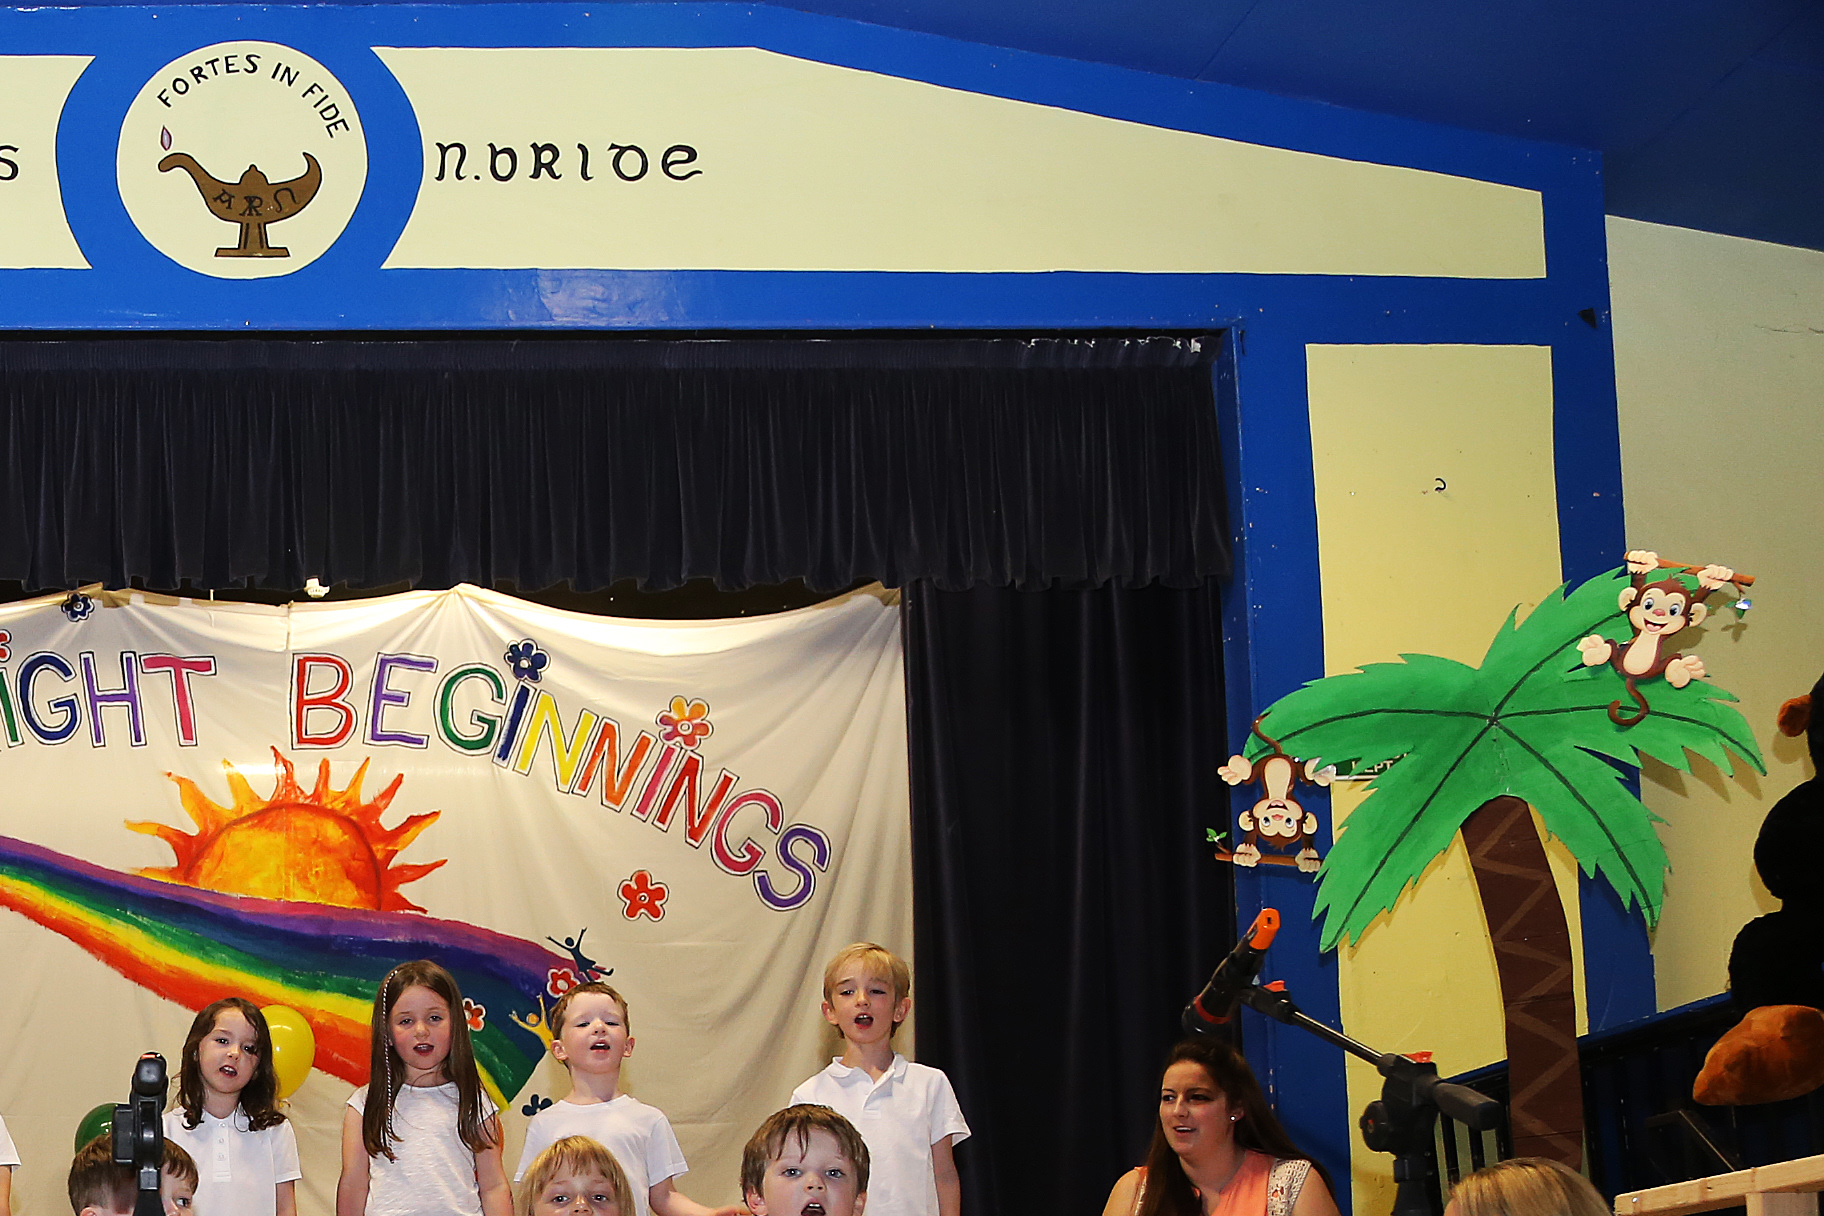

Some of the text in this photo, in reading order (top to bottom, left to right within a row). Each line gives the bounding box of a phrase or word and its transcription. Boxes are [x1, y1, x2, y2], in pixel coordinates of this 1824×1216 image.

[157, 54, 350, 138] FORTES IN FIDE
[289, 652, 831, 911] BEGINNINGS
